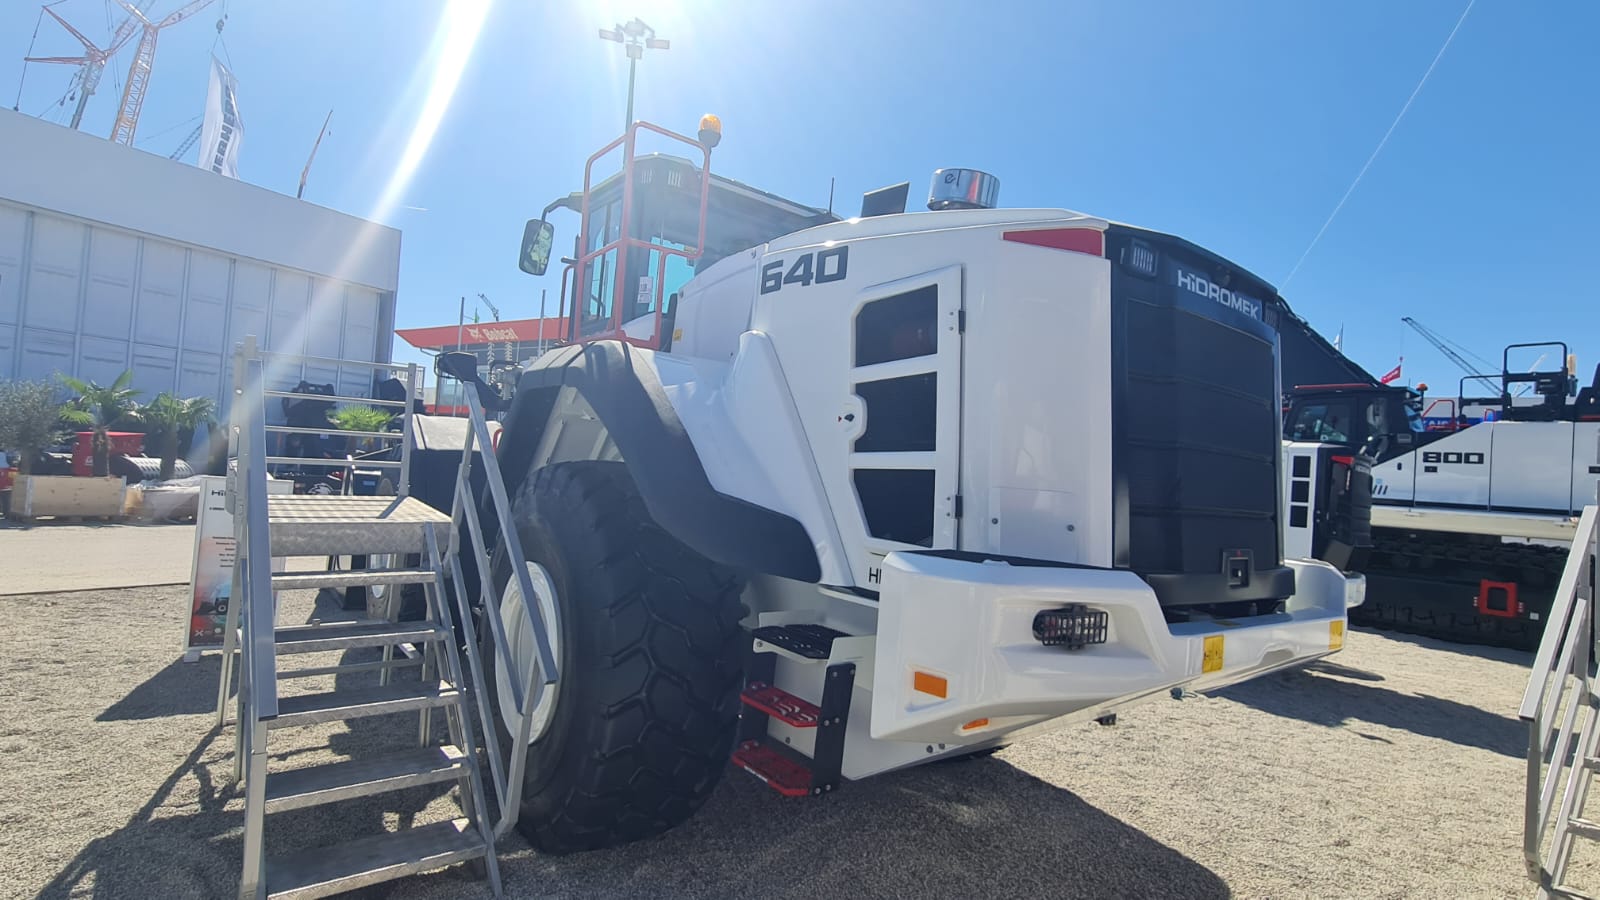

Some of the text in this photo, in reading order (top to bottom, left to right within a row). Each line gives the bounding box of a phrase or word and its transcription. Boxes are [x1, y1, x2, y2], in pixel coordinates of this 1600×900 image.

[760, 245, 849, 296] 640
[482, 327, 519, 341] Bobcat
[1422, 451, 1485, 465] 800
